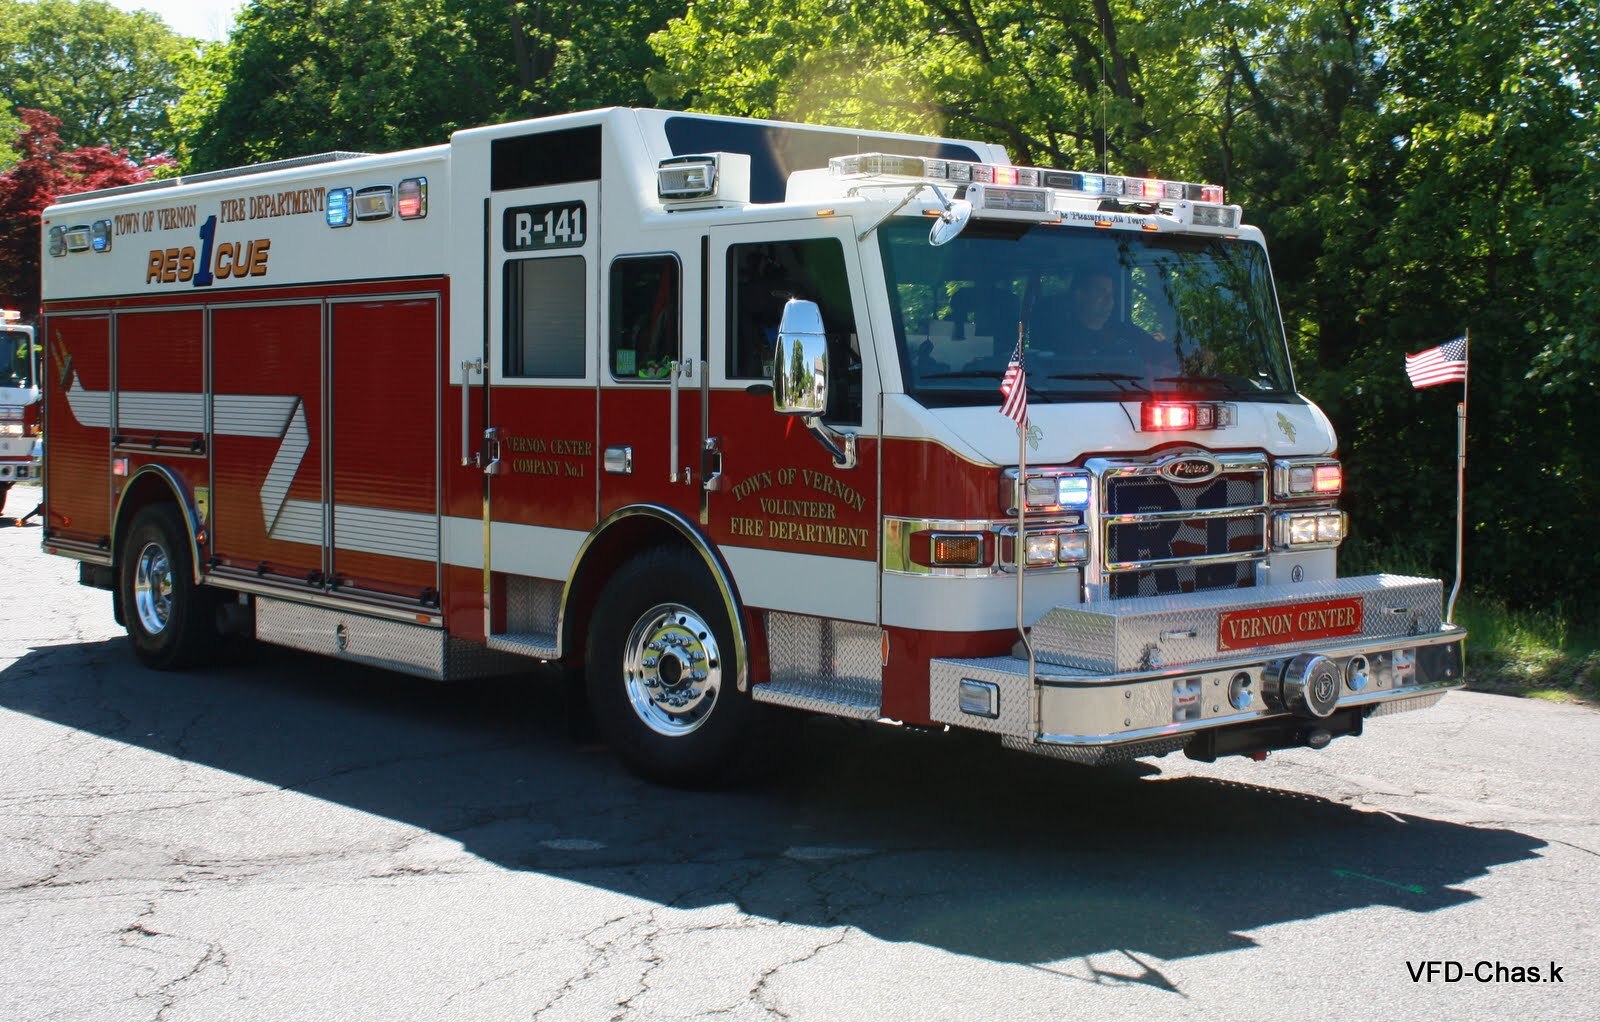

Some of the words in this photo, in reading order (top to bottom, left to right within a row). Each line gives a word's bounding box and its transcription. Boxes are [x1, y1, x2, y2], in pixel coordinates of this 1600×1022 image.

[115, 213, 140, 236] TOWN
[142, 211, 154, 232] OF
[155, 204, 197, 231] VERNON
[220, 196, 246, 223] FIRE
[249, 187, 326, 220] DEPARTMENT
[515, 207, 583, 246] R-141
[506, 437, 546, 453] VERNON
[550, 439, 592, 456] CENTER
[513, 458, 560, 476] COMPANY
[1174, 461, 1209, 476] Pierce
[731, 470, 773, 502] TOWN
[778, 468, 797, 486] OF
[801, 469, 866, 513] VERNON
[760, 498, 836, 519] VOLUNTEER
[730, 516, 764, 537] FIRE
[768, 520, 869, 548] DEPARTMENT
[1229, 613, 1293, 640] VERNON
[1298, 606, 1356, 632] CENTER
